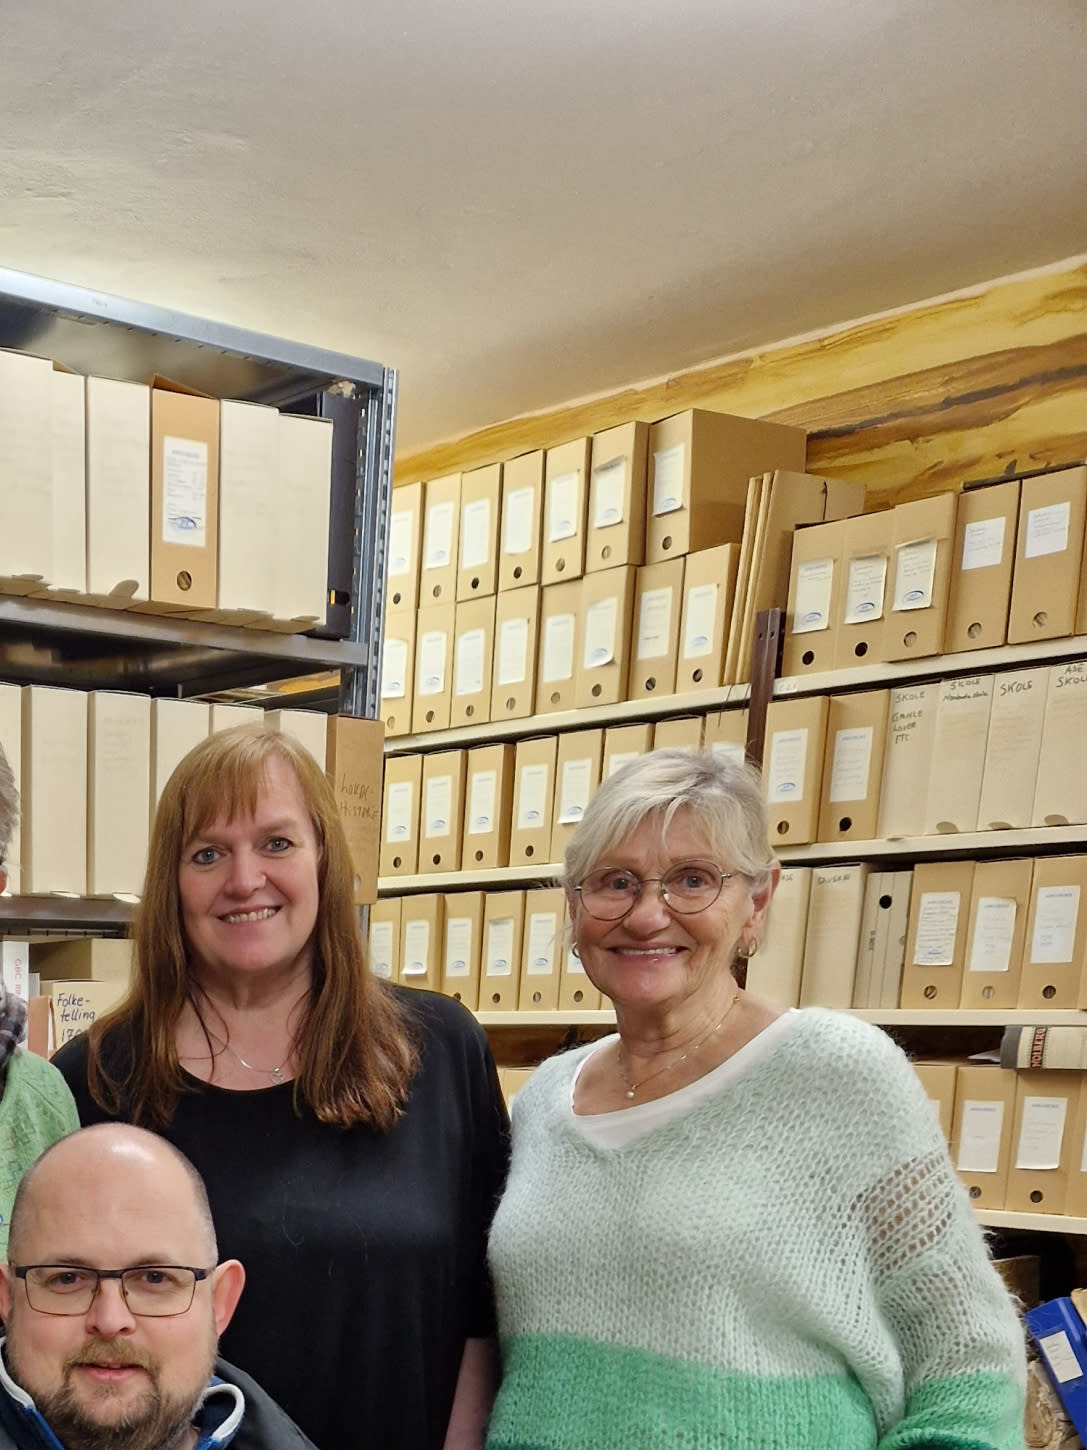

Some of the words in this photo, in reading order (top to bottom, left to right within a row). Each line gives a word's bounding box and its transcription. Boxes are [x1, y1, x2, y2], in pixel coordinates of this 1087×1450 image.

[950, 678, 981, 690] SKOLE
[1000, 680, 1033, 696] SKOLE
[1055, 676, 1087, 688] SKOL
[895, 691, 925, 703] SKOLE
[57, 993, 91, 1006] Folke-
[60, 1009, 96, 1022] telling
